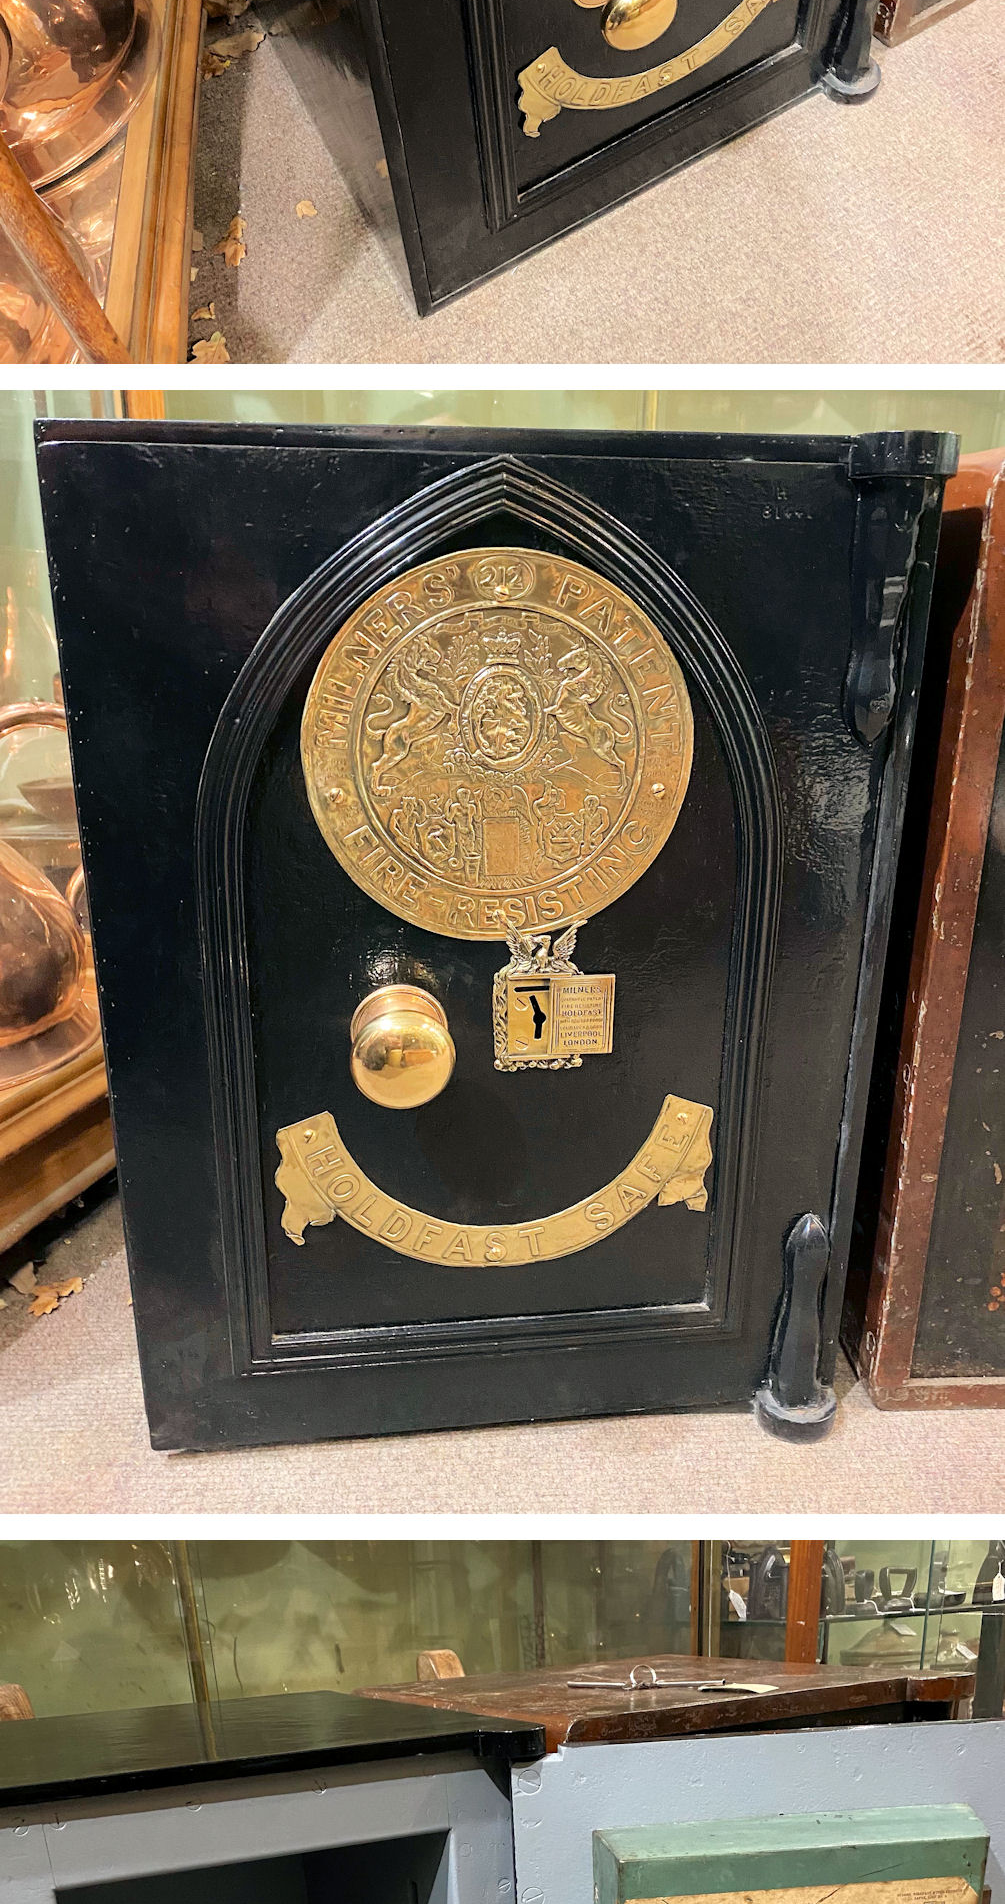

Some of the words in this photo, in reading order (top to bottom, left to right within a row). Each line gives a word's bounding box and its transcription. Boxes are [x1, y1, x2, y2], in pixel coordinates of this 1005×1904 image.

[539, 49, 700, 106] HOLDFAST
[557, 574, 681, 756] PATENT
[561, 1009, 601, 1017] HOLDFAST
[562, 986, 602, 994] MILNERS
[307, 1145, 546, 1262] HOLDFAST
[583, 1124, 690, 1232] SAFE
